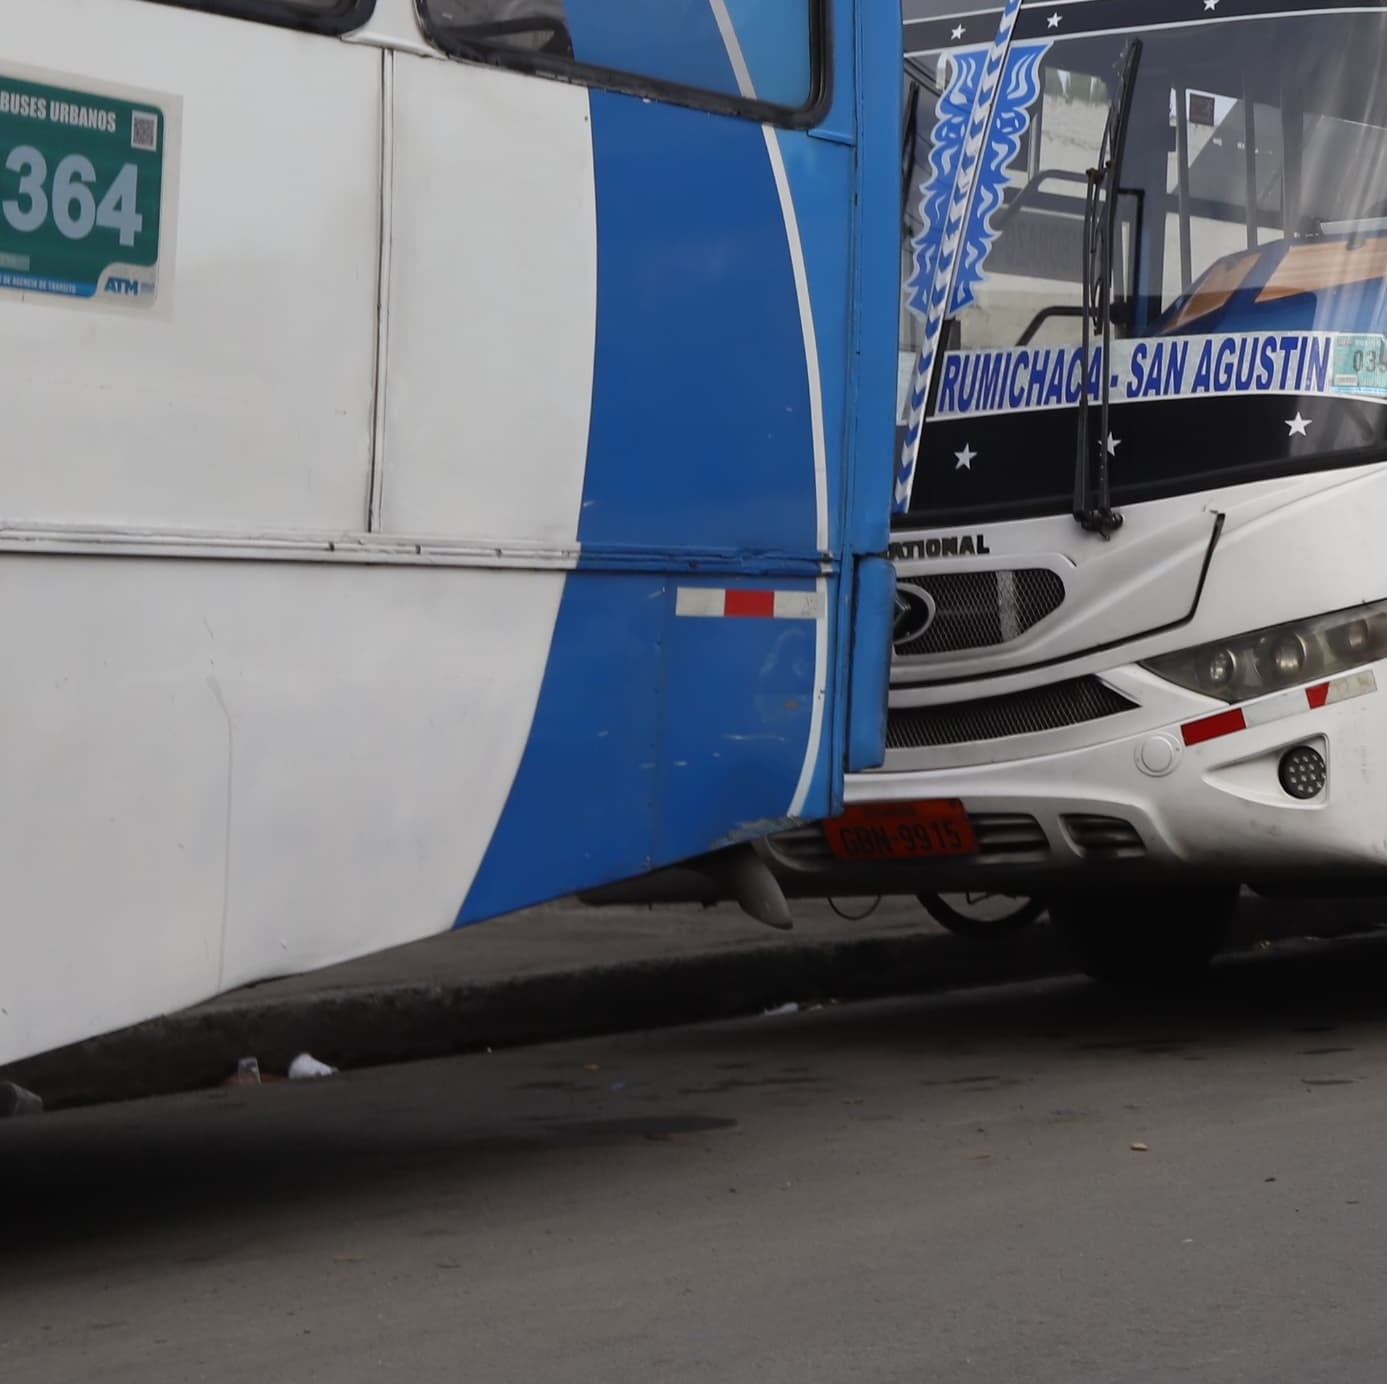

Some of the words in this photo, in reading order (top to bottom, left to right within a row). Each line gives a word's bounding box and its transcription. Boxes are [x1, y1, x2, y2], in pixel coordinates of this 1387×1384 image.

[0, 91, 47, 118] BUSES
[51, 101, 116, 132] URBANOS
[2, 144, 142, 247] 364
[105, 277, 139, 296] ATM
[938, 346, 1102, 413] RUMICHACA
[1126, 341, 1189, 398] SAN
[1191, 336, 1331, 393] AGUSTIN
